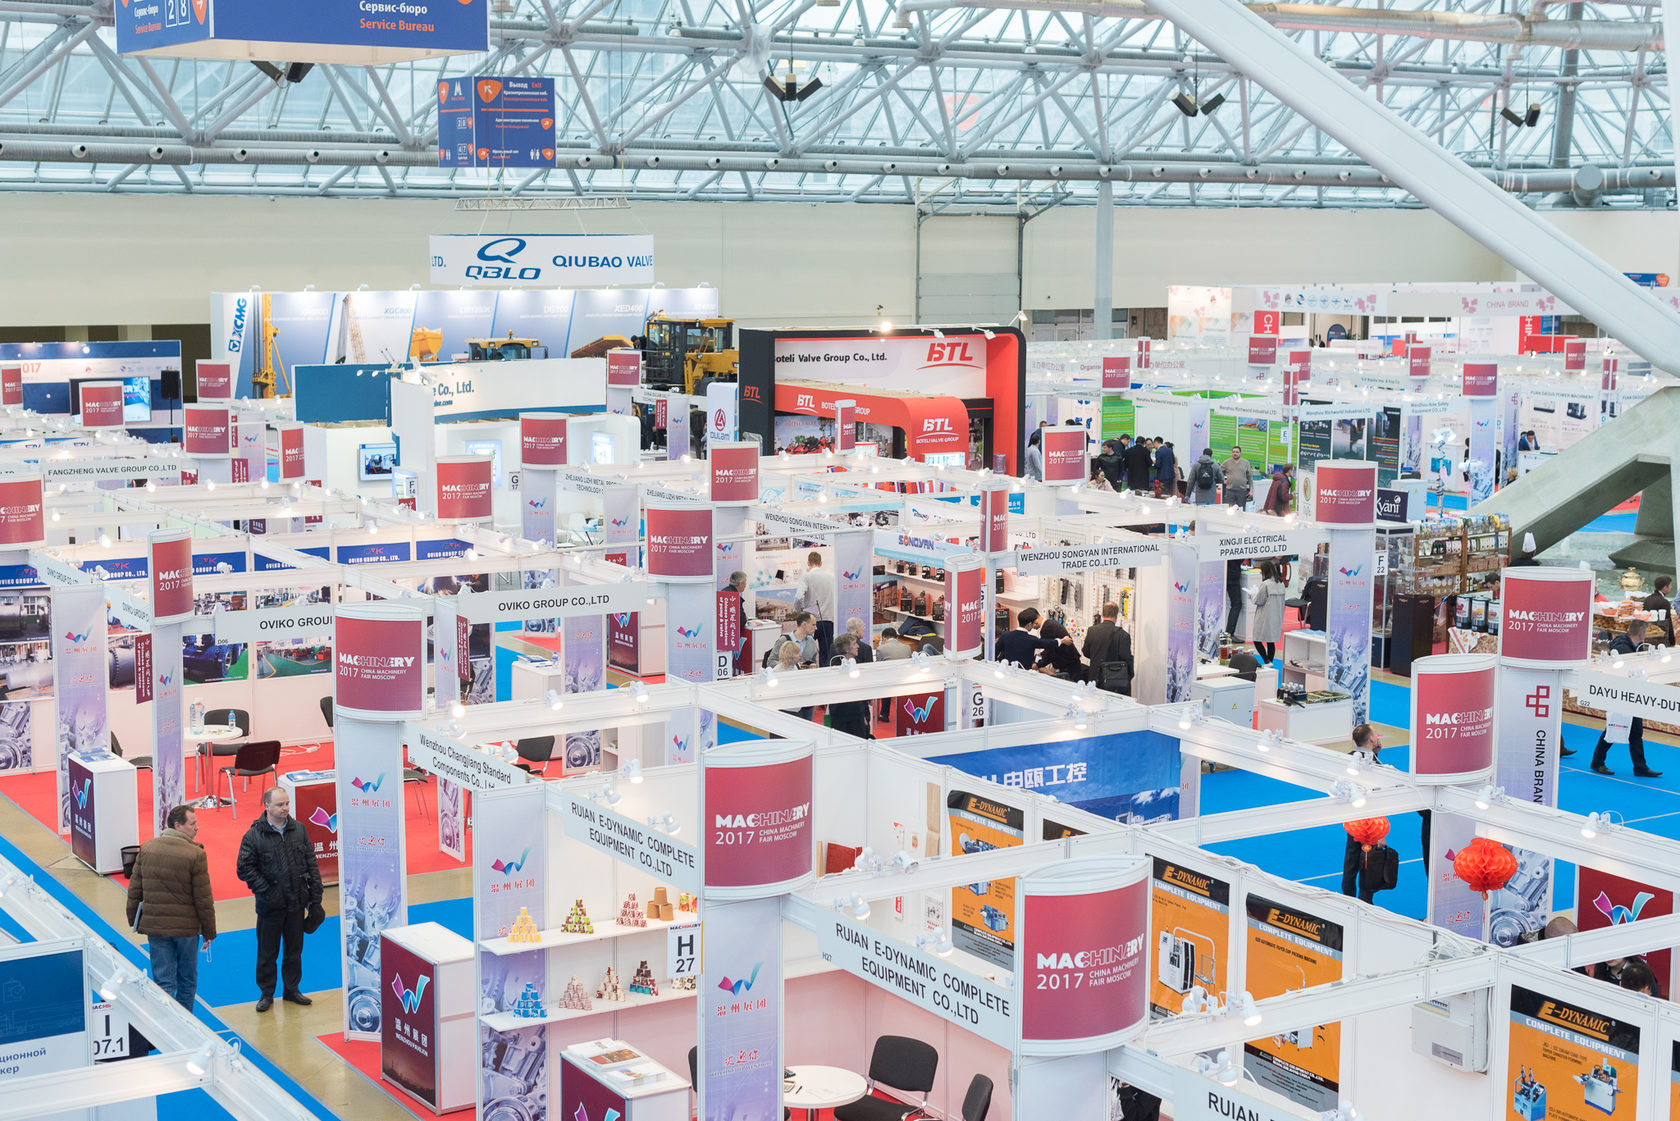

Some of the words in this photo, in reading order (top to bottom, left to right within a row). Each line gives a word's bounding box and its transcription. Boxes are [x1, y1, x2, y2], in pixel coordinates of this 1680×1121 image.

[134, 4, 159, 19] Сервис-бюро
[168, 0, 175, 20] 2
[181, 0, 186, 17] 8
[360, 0, 427, 16] Сервис-бюро
[135, 23, 148, 34] Service
[148, 22, 161, 31] Bureau
[360, 18, 396, 30] Service
[399, 20, 434, 32] Bureau
[432, 256, 447, 267] LTD.
[552, 255, 623, 268] QIUBAO
[465, 265, 541, 280] QBLO
[1486, 301, 1505, 309] CHINA
[1508, 300, 1529, 308] BRAND
[237, 298, 247, 338] XCMG
[775, 354, 795, 363] oteli
[798, 354, 821, 363] Valve
[824, 354, 850, 364] Group
[853, 354, 870, 363] Co.,
[872, 353, 888, 361] Ltd.
[927, 342, 974, 362] BTL
[438, 383, 454, 397] Co.,
[456, 380, 475, 394] Ltd.
[744, 385, 761, 399] BTL
[797, 394, 815, 408] BTL
[923, 418, 953, 431] BTL
[48, 468, 94, 476] FANGZHENG
[121, 466, 147, 474] GROUP
[512, 476, 519, 484] G
[566, 474, 583, 484] ZHEJIANG
[442, 483, 490, 492] MACHINERY
[647, 489, 666, 499] ZHEJIANG
[1320, 489, 1372, 497] MACHINERY
[1320, 496, 1336, 504] 2017
[765, 514, 789, 524] WENZHOU
[789, 518, 812, 529] SONGYAN
[994, 523, 1006, 531] 2017
[651, 535, 709, 545] MACHINERY
[898, 535, 935, 551] SONGYAN
[1219, 537, 1243, 547] XINGJI
[1244, 534, 1287, 545] ELECTRICAL
[651, 545, 667, 553] 2017
[1021, 553, 1060, 562] WENZHOU
[1062, 550, 1100, 559] SONGYAN
[1101, 544, 1160, 556] INTERNATIONAL
[1220, 546, 1259, 557] PPARATUS
[1259, 544, 1288, 554] CO.,LTD
[1062, 561, 1088, 569] TRADE
[1089, 558, 1121, 568] CO.,LTD.
[1378, 556, 1384, 566] F
[160, 580, 180, 591] 2017
[499, 601, 531, 612] OVIKO
[533, 598, 569, 609] GROUP
[571, 595, 610, 606] CO.,LTD
[962, 613, 977, 624] 2017
[1509, 609, 1585, 623] MACHINERY
[260, 618, 295, 630] OVIKO
[1509, 620, 1534, 632] 2017
[340, 651, 415, 668] MACHINERY
[718, 656, 727, 667] D
[340, 666, 358, 678] 2017
[718, 668, 728, 676] 06
[973, 692, 984, 706] G
[1590, 685, 1618, 700] DAYU
[1621, 691, 1680, 712] HEAVY-DUT
[973, 707, 984, 717] 26
[1426, 707, 1493, 726] MACHINERY
[1426, 727, 1458, 739] 2017
[1460, 724, 1475, 732] CHINA
[1460, 731, 1471, 739] FAIR
[1471, 729, 1488, 737] MOSCOW
[1535, 729, 1546, 767] CHINA
[420, 734, 447, 756] Wenzhou
[448, 746, 482, 774] Changjiang
[483, 762, 511, 784] Standard
[433, 756, 470, 784] Components
[967, 797, 1008, 819] E-DYNAMIC
[715, 802, 810, 829] MACHINERY
[759, 827, 778, 837] CHINA
[779, 822, 805, 834] MACHINERY
[960, 811, 986, 826] COMPLETE
[988, 820, 1017, 836] EQUIPMENT
[571, 802, 596, 824] RUIAN
[600, 814, 644, 846] E-DYNAMIC
[648, 836, 695, 869] COMPLETE
[715, 831, 755, 845] 2017
[759, 835, 772, 844] FAIR
[773, 831, 798, 841] MOSCOW
[590, 828, 635, 860] EQUIPMENT
[640, 852, 673, 877] CO.,LTD
[1162, 866, 1210, 892] E-DYNAMIC
[1155, 881, 1185, 899] COMPLETE
[1187, 892, 1221, 912] EQUIPMENT
[1266, 908, 1321, 936] E-DYNAMIC
[678, 934, 694, 957] H
[1259, 923, 1292, 942] COMPLETE
[1295, 936, 1333, 957] EQUIPMENT
[822, 952, 833, 962] H27
[1037, 933, 1144, 970] MACHINERY
[676, 958, 695, 973] 27
[836, 922, 869, 951] RUIAN
[875, 940, 937, 982] E-DYNAMIC
[943, 973, 1010, 1018] COMPLETE
[1089, 966, 1112, 979] CHINA
[1112, 959, 1139, 975] MACHINERY
[1037, 973, 1084, 990] 2017
[1089, 977, 1105, 988] FAIR
[1106, 970, 1132, 985] MOSCOW
[862, 958, 927, 999] EQUIPMENT
[933, 990, 979, 1025] CO.,LTD
[1537, 1001, 1610, 1035] E-DYNAMIC
[395, 1017, 428, 1048] 温州展团
[1526, 1018, 1571, 1040] COMPLETE
[1574, 1032, 1626, 1060] EQUIPMENT
[1209, 1092, 1259, 1121] RUIAN
